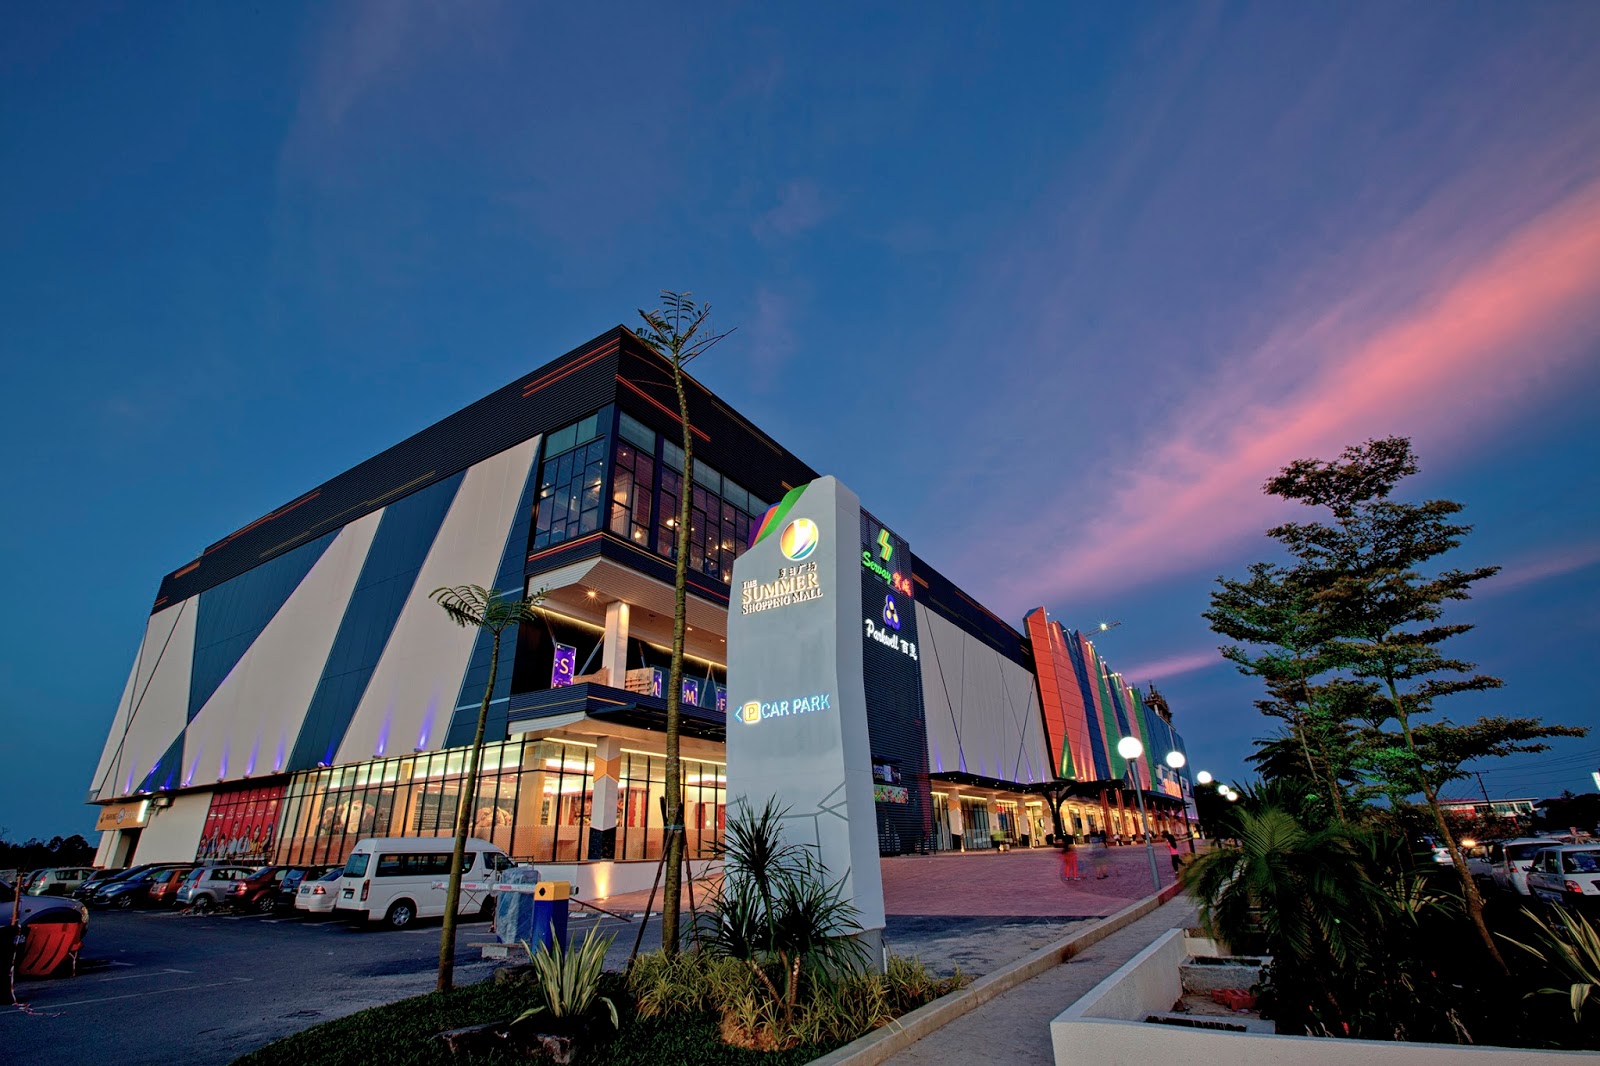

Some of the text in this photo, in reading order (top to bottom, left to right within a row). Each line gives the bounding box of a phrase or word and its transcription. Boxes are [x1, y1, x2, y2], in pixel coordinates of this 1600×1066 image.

[742, 571, 820, 605] SUMMER
[741, 588, 824, 615] SHOPPING MALL
[559, 657, 570, 675] S
[685, 689, 696, 704] M
[761, 700, 790, 719] CAR
[792, 694, 831, 715] PARK
